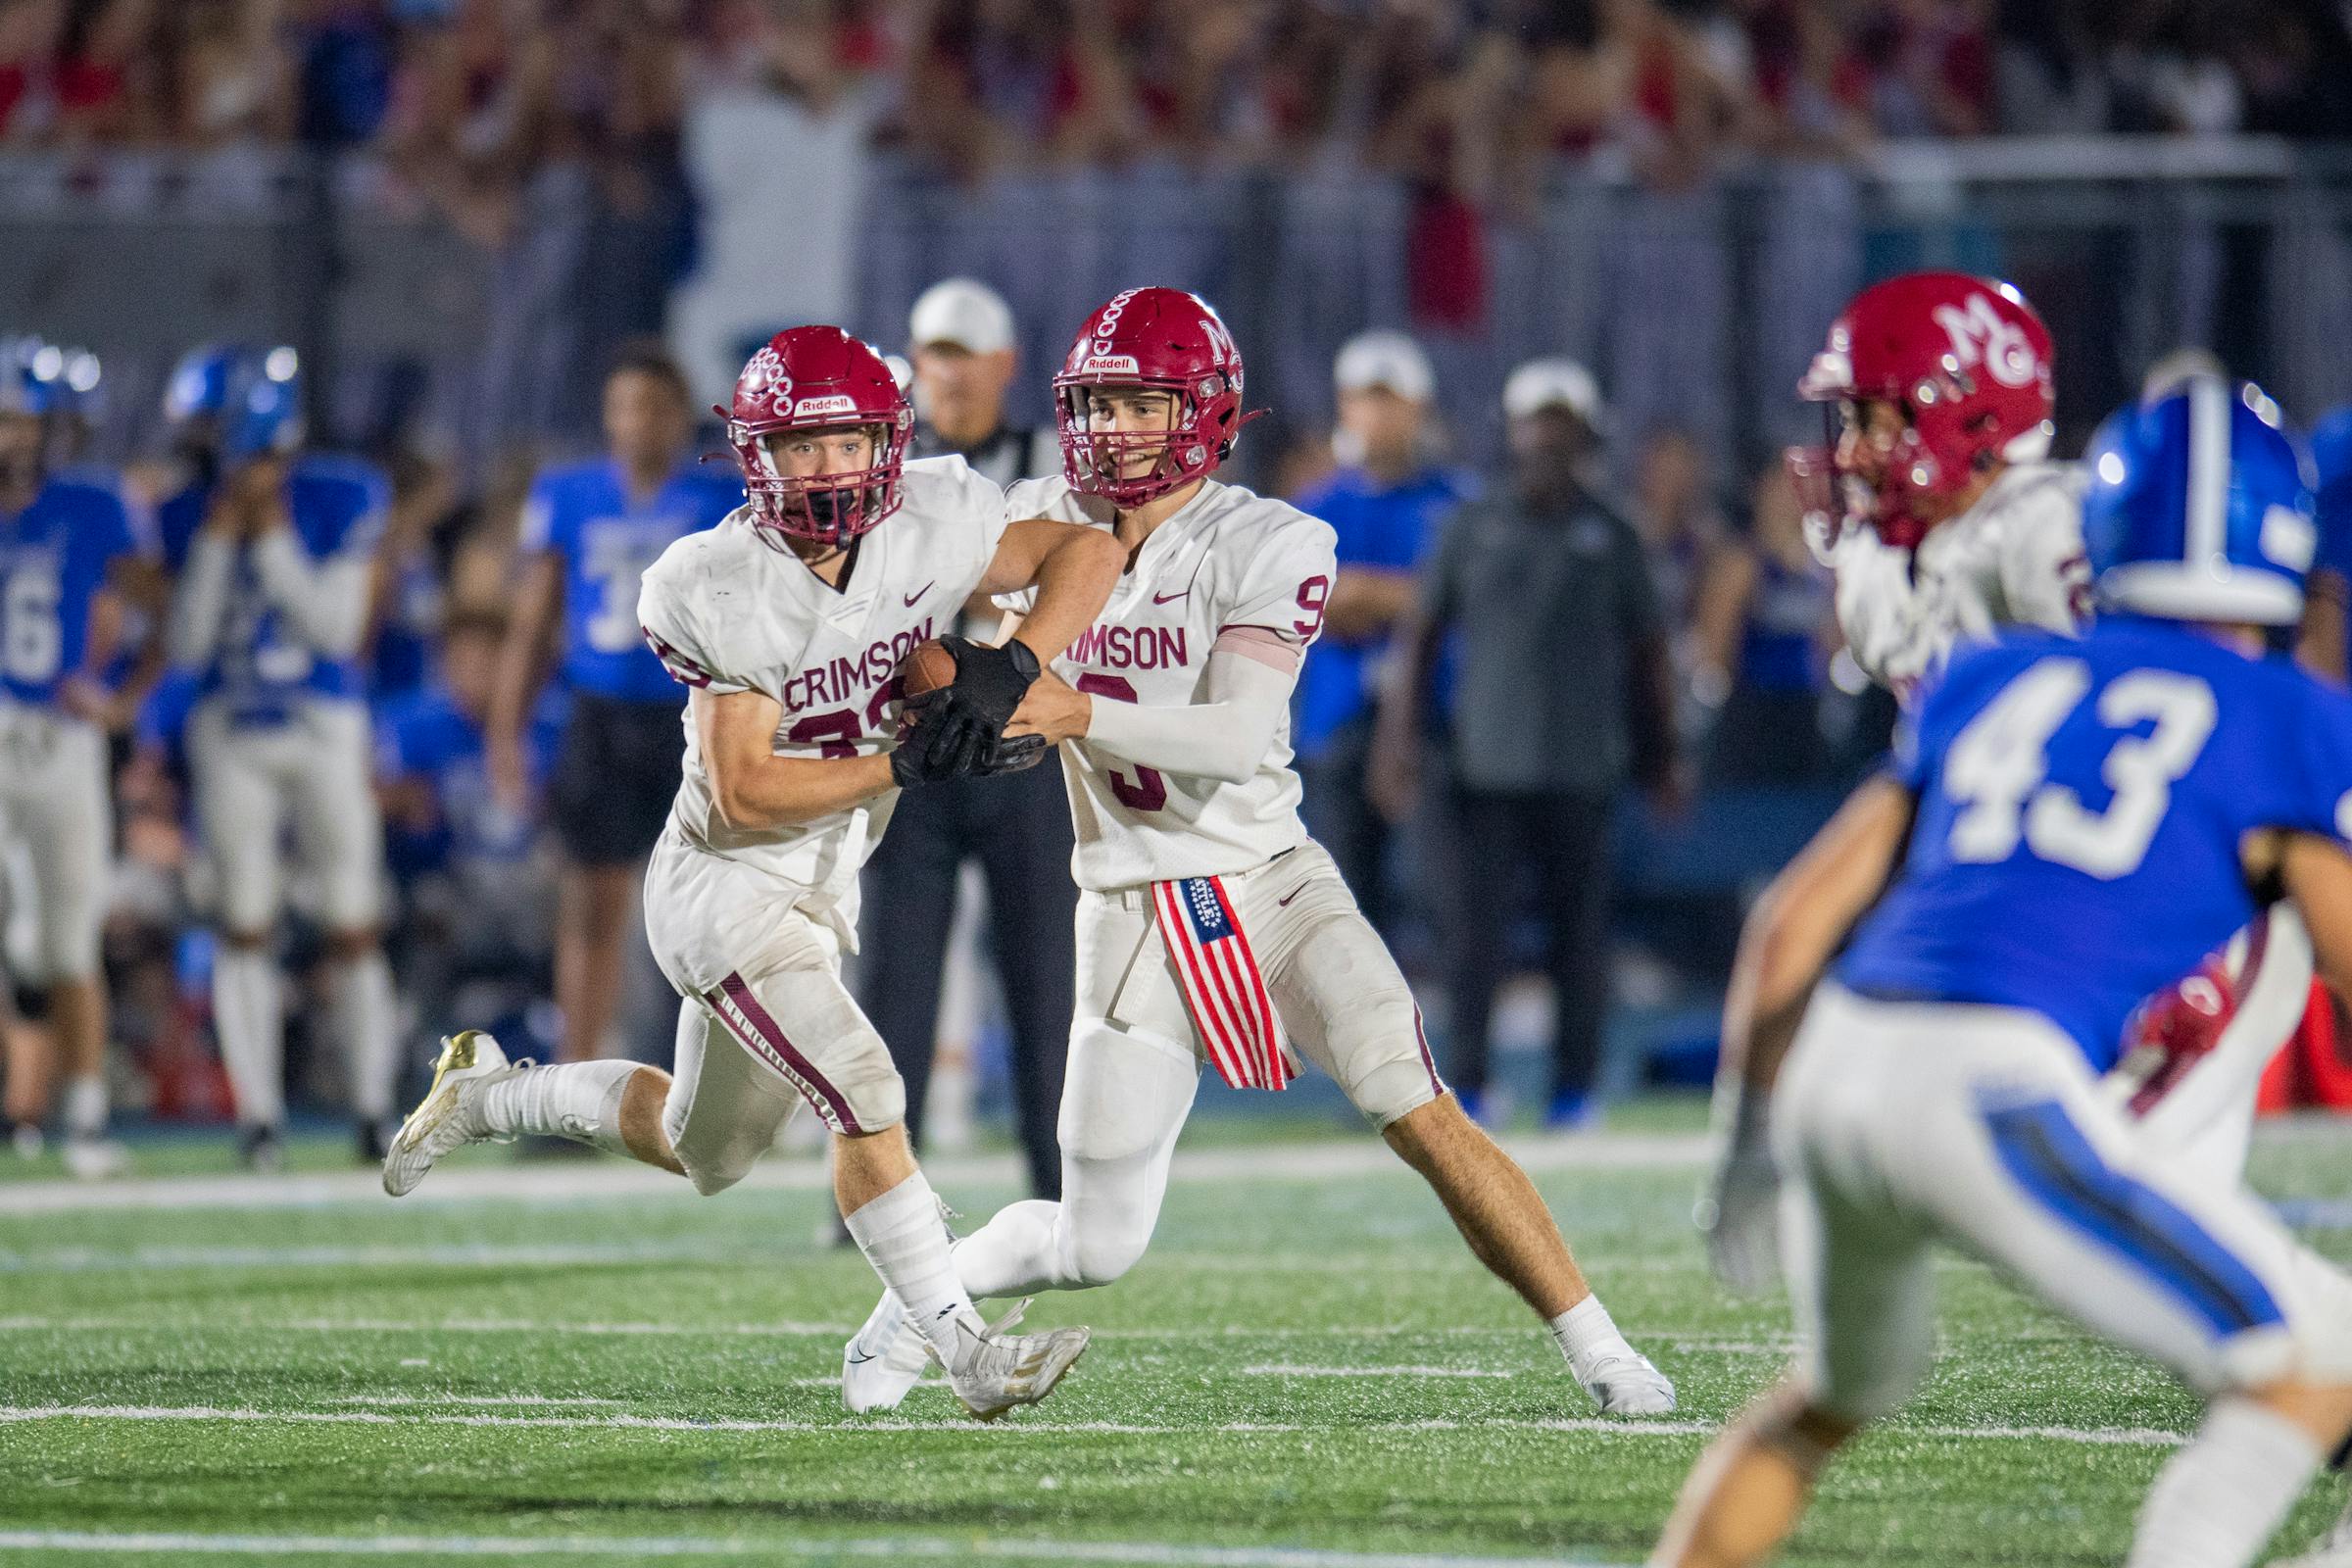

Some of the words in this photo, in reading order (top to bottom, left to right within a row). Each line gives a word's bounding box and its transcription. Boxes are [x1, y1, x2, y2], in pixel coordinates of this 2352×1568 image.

[1089, 359, 1129, 368] Riddell
[802, 398, 848, 412] Riddell
[1293, 574, 1329, 647] 9
[1066, 624, 1188, 670] IMSON
[1942, 655, 2219, 880] 43
[1194, 878, 1216, 919] ATTLE
